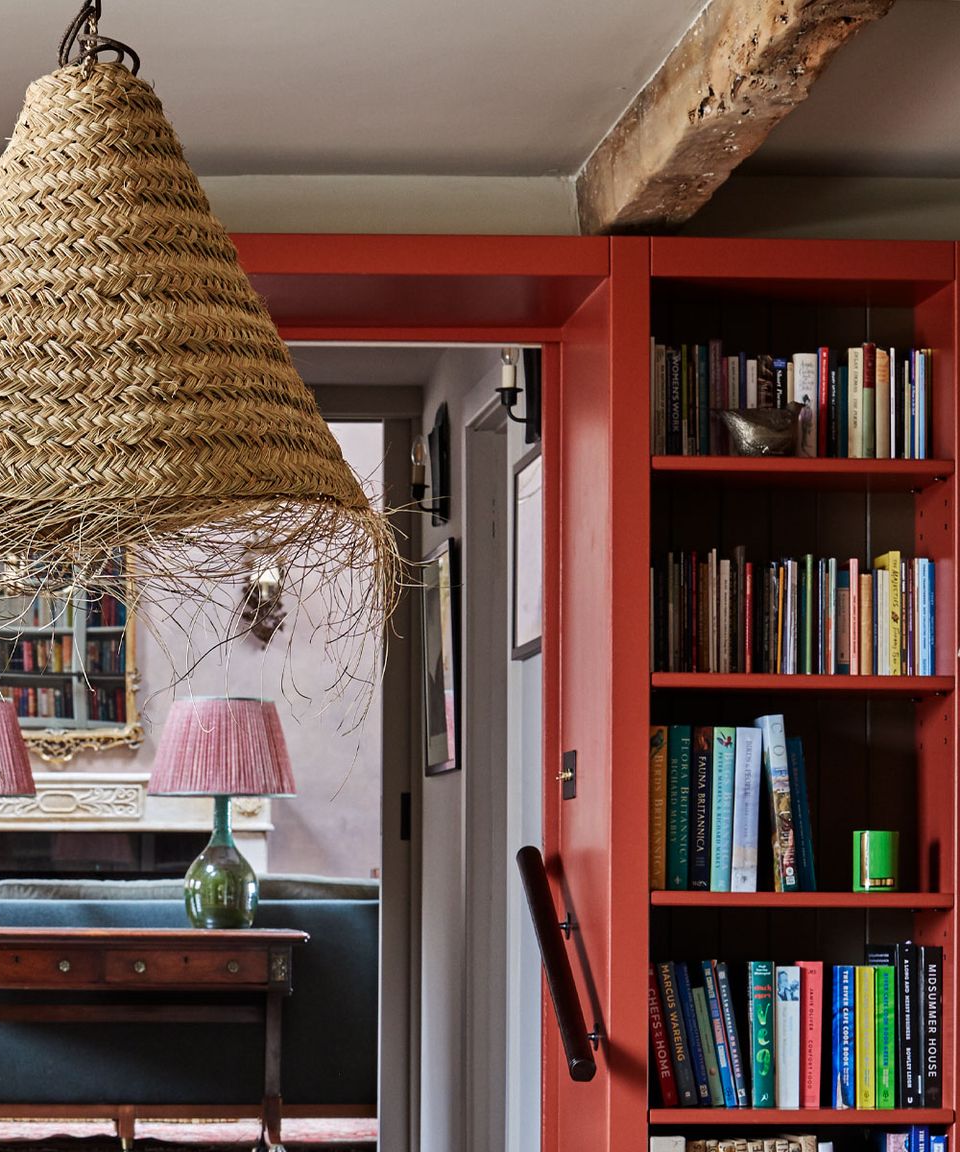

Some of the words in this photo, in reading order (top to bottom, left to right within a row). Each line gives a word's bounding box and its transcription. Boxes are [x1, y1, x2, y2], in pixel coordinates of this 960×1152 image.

[654, 755, 663, 792] BIRDS
[680, 738, 690, 779] FLORA
[698, 756, 706, 789] FAUNA
[723, 752, 733, 786] BUGS
[670, 759, 679, 805] RICHARD
[743, 769, 751, 797] PEOPLE
[654, 799, 663, 876] BRITANNICA
[669, 810, 678, 844] MABEY
[679, 787, 690, 864] BRITANNICA
[696, 793, 705, 852] BRITANNICA
[722, 792, 733, 870] BRITANNICA
[661, 965, 675, 1008] MARCUS
[670, 1011, 685, 1062] WAREING
[723, 999, 733, 1033] Lawrence
[928, 964, 937, 1034] MIDSUMMER
[648, 988, 662, 1029] CHEFS
[656, 1040, 670, 1079] HOME
[730, 1035, 736, 1047] ON
[732, 1049, 742, 1078] BAKING
[928, 1038, 937, 1078] HOUSE
